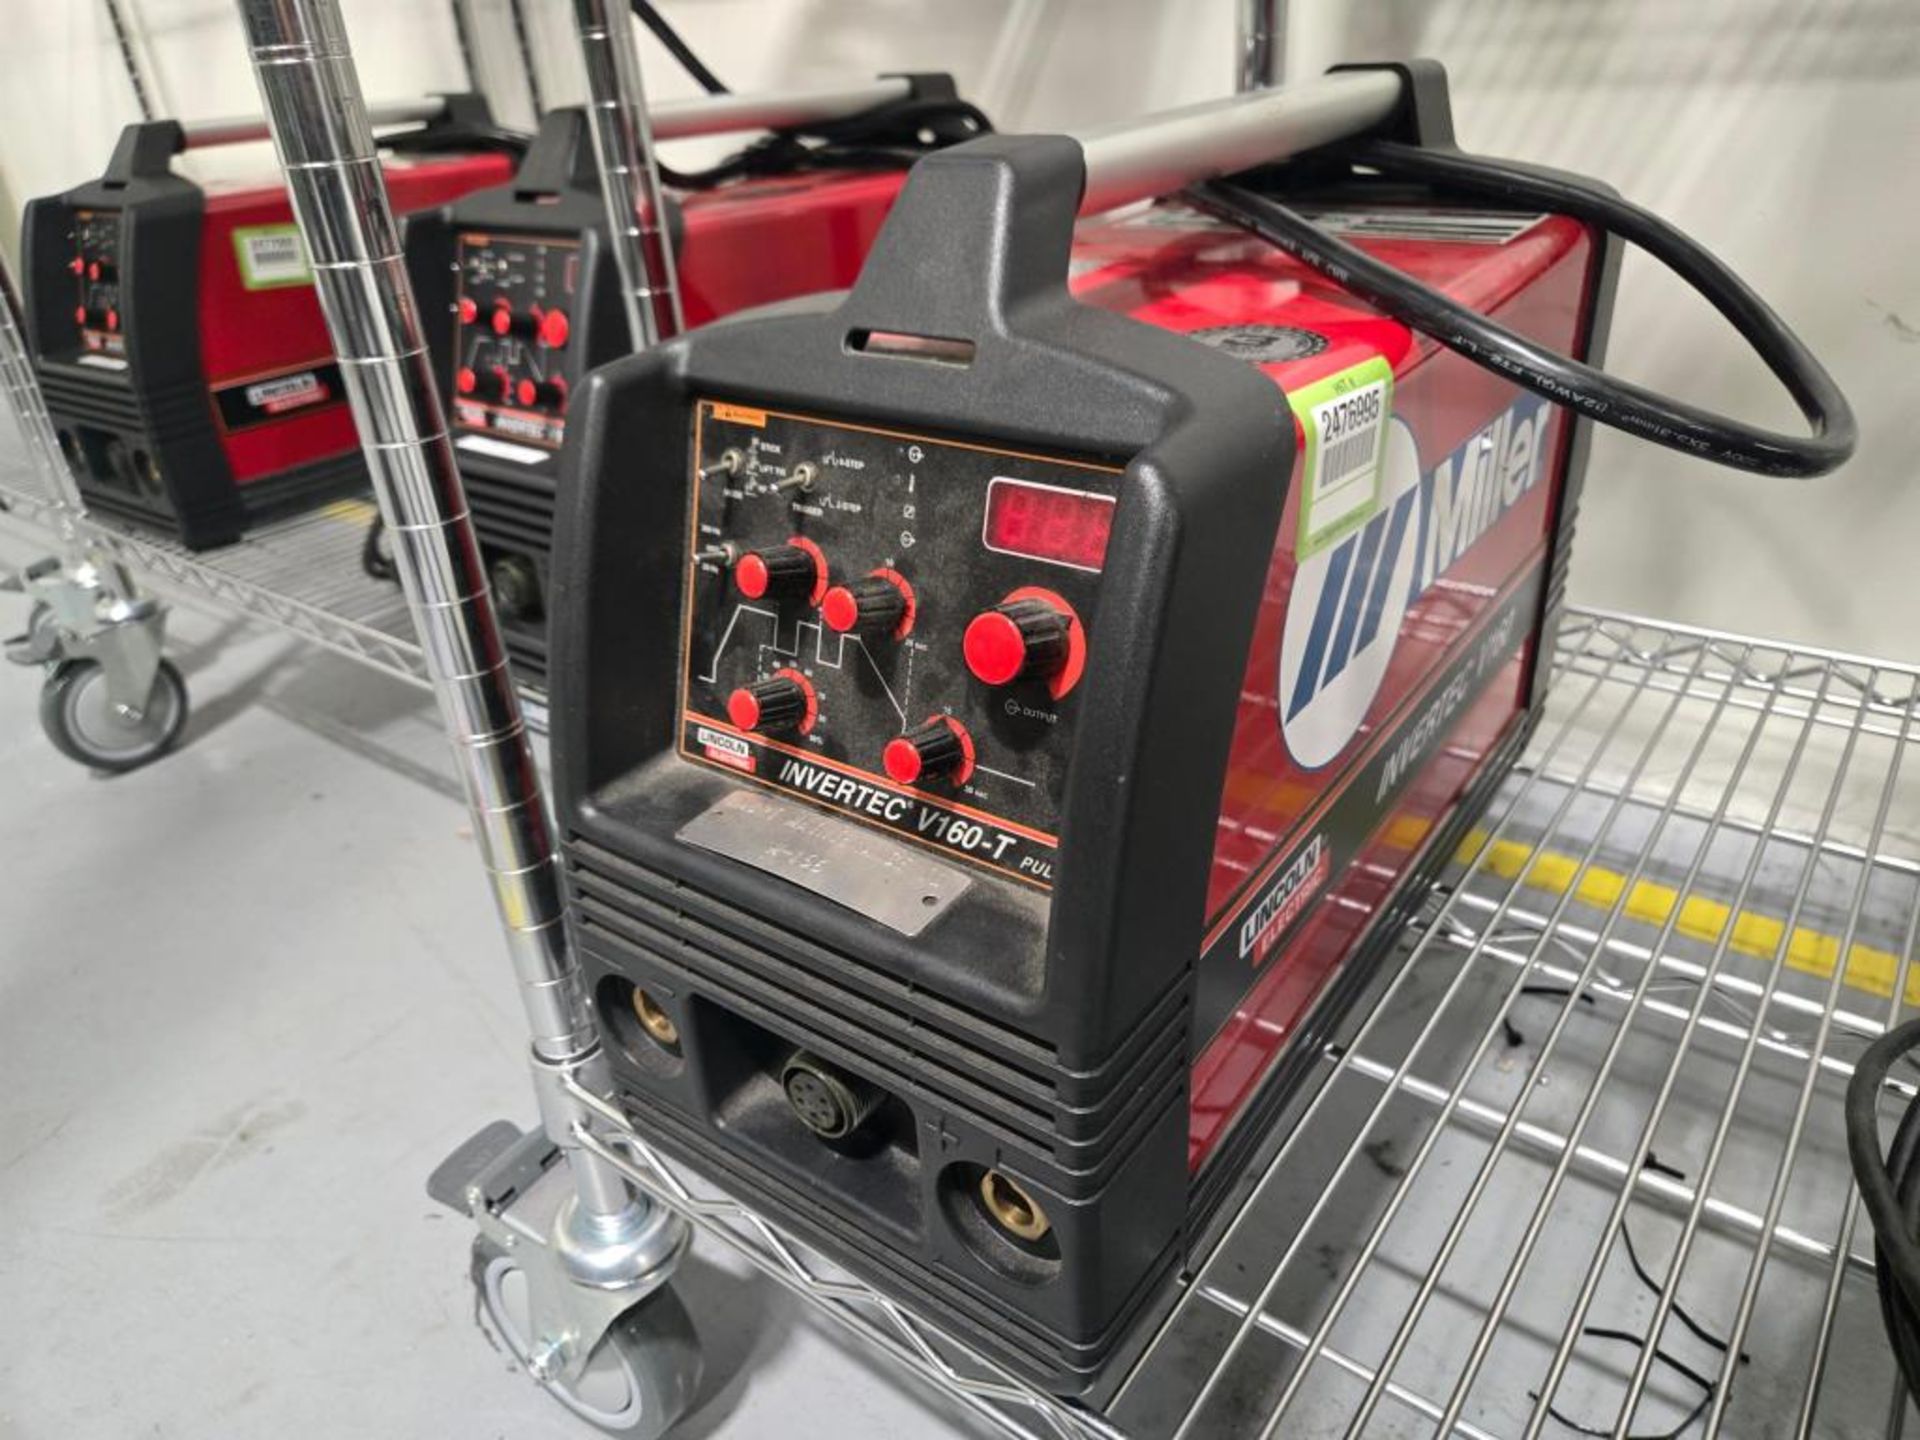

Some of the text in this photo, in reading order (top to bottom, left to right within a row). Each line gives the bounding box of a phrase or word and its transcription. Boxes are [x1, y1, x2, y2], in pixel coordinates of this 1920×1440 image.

[1420, 400, 1550, 594] Miller
[701, 730, 746, 754] LINCOLN
[1023, 707, 1058, 724] OUTPUT
[917, 806, 1017, 860] V160-T
[1244, 841, 1318, 947] LINCOLN
